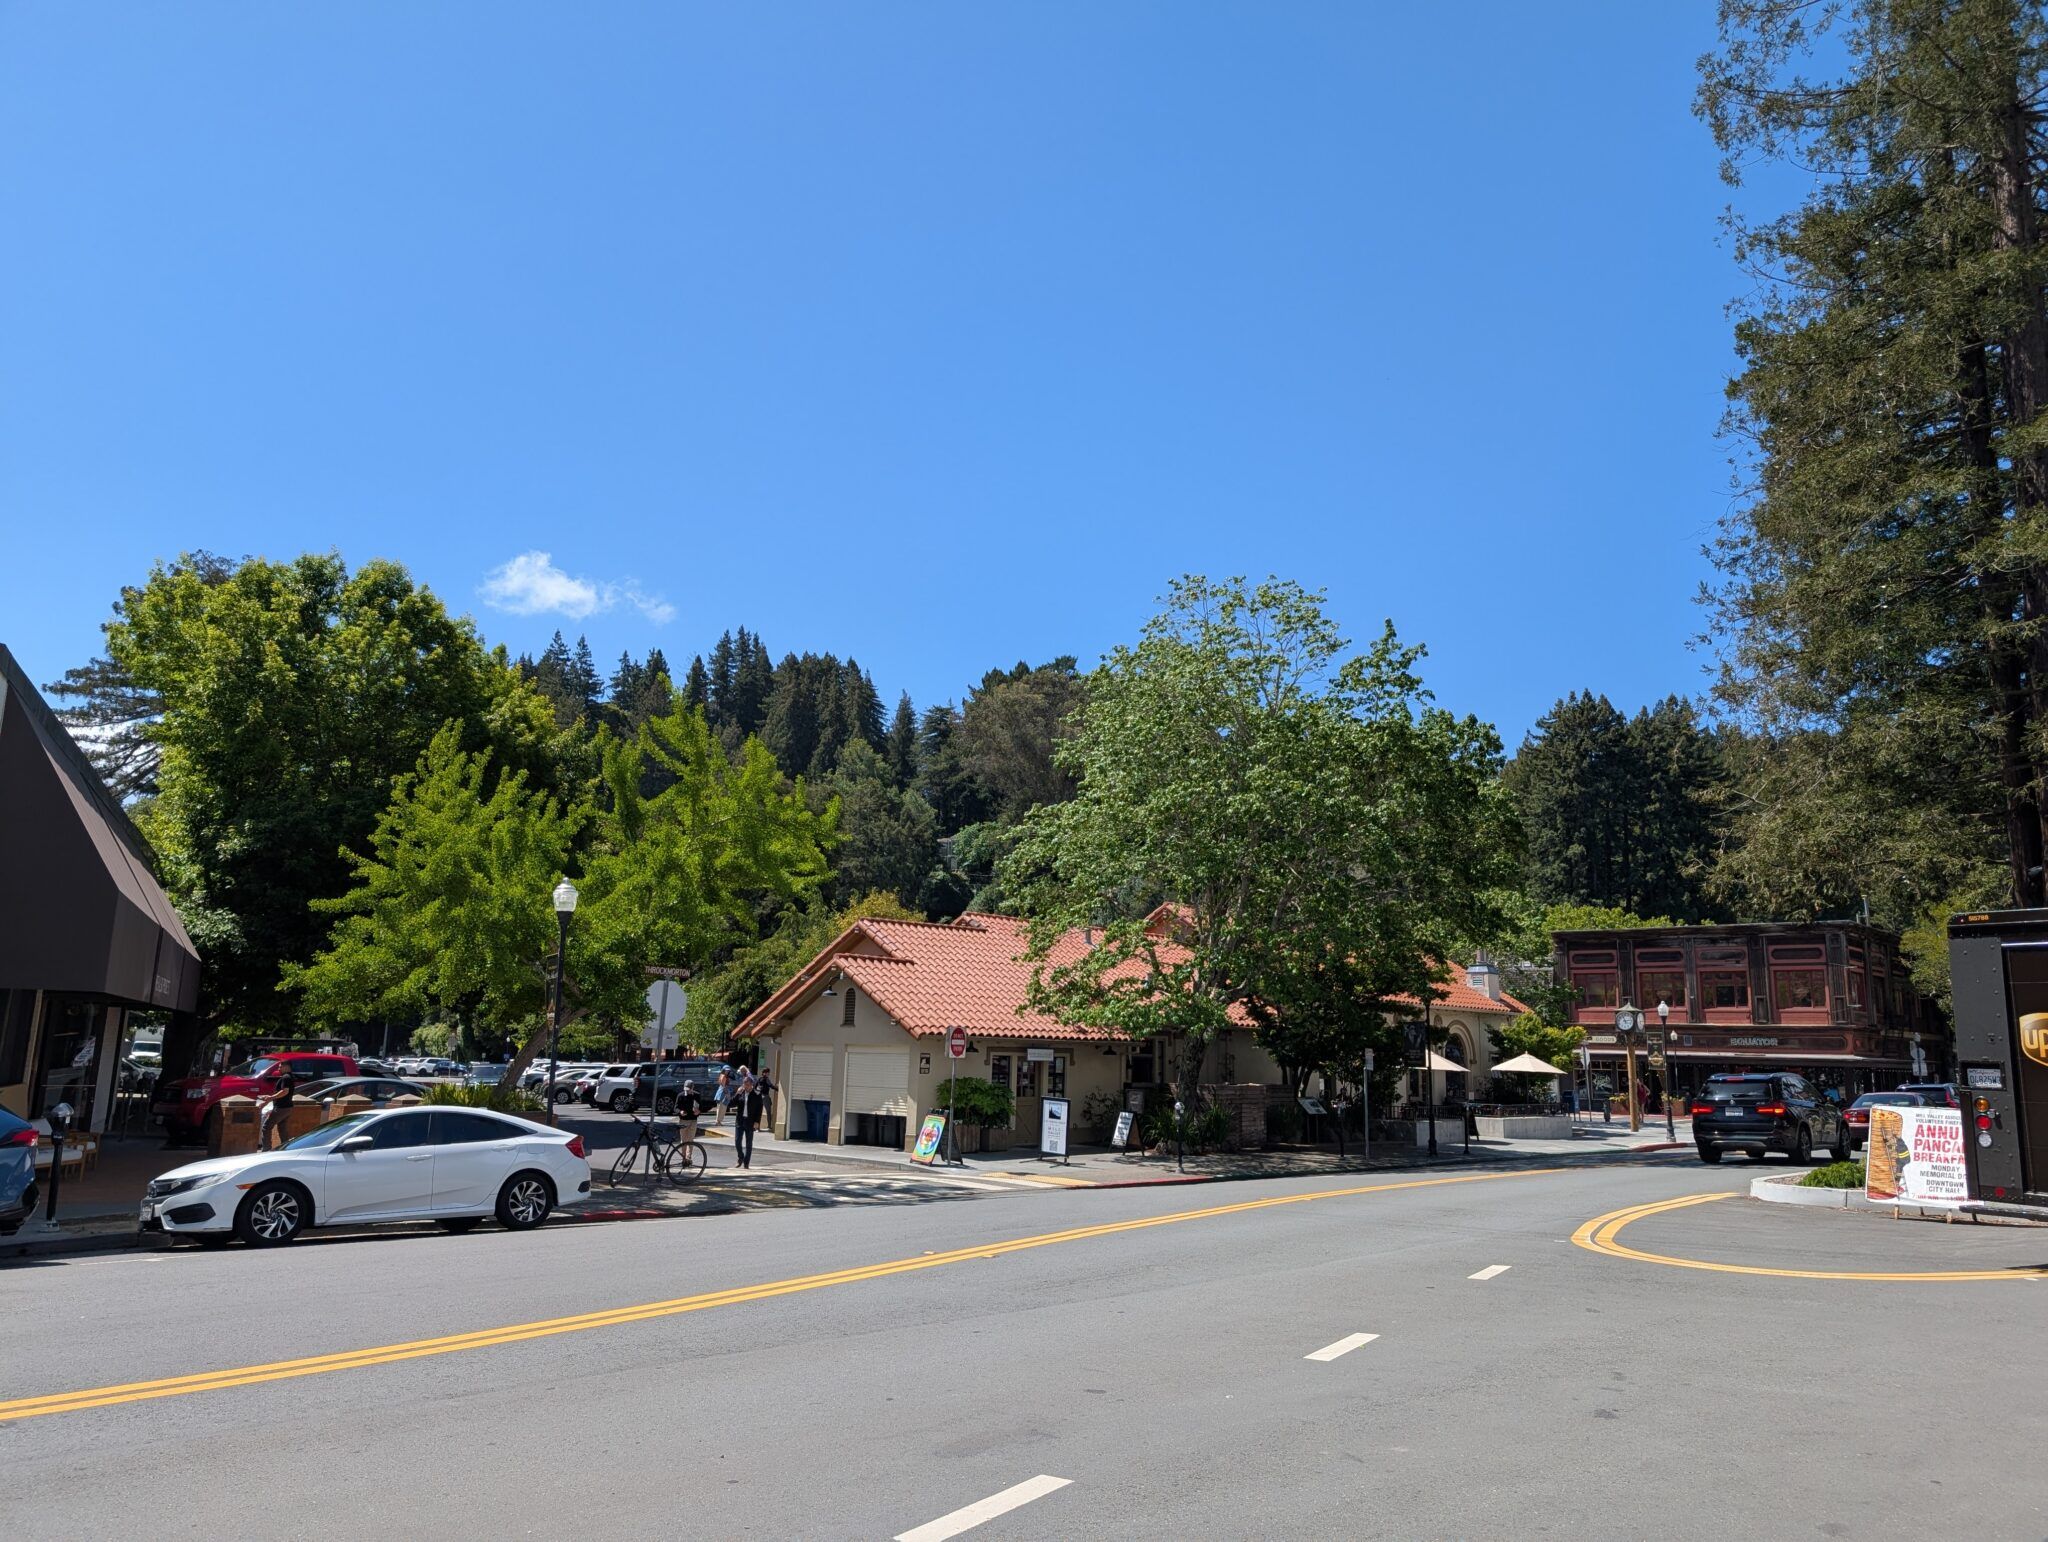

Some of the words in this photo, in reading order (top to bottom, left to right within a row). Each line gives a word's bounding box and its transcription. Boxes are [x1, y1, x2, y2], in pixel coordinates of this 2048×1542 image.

[645, 966, 691, 977] THROCKMORTON
[1730, 1037, 1778, 1047] EQUATOR
[2024, 1029, 2048, 1058] up
[1915, 1124, 1964, 1140] ANNU
[1914, 1138, 1965, 1153] PANCA
[1913, 1152, 1965, 1164] BREAKFA
[1931, 1164, 1960, 1172] MONDAY
[1920, 1170, 1955, 1179] MEMORIAL
[1926, 1179, 1964, 1188] DOWNTOWN
